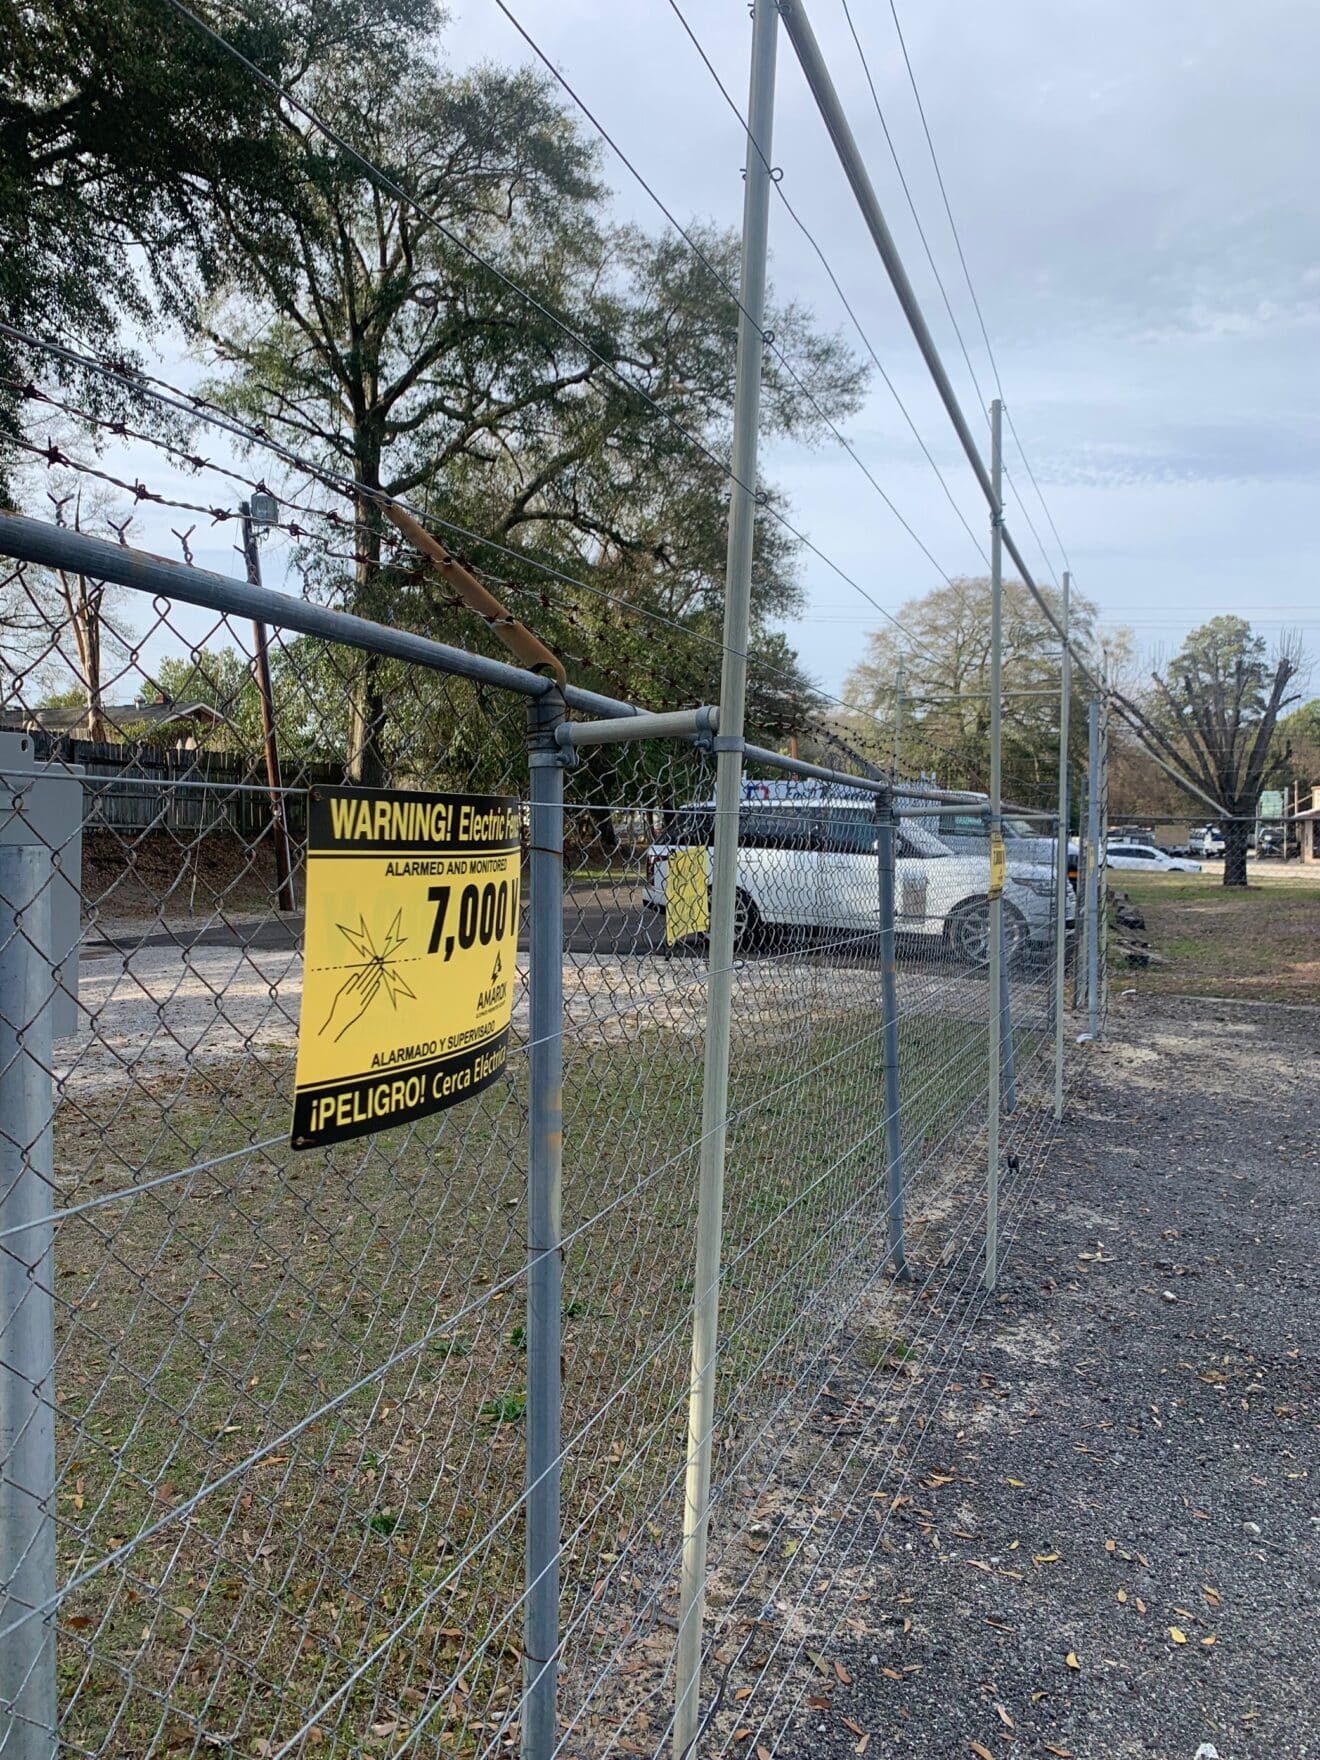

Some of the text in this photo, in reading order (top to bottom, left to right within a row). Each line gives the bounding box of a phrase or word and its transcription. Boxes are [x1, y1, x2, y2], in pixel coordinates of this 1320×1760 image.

[330, 798, 520, 842] WARNING! Electric Fen
[385, 858, 507, 877] ALARMED AND MONITORED
[427, 877, 519, 963] 7,000 V
[371, 1020, 496, 1069] ALARMADO Y SUPERVISADO
[310, 1044, 507, 1132] ¡PELIGRO! Cerca Eléctrica
